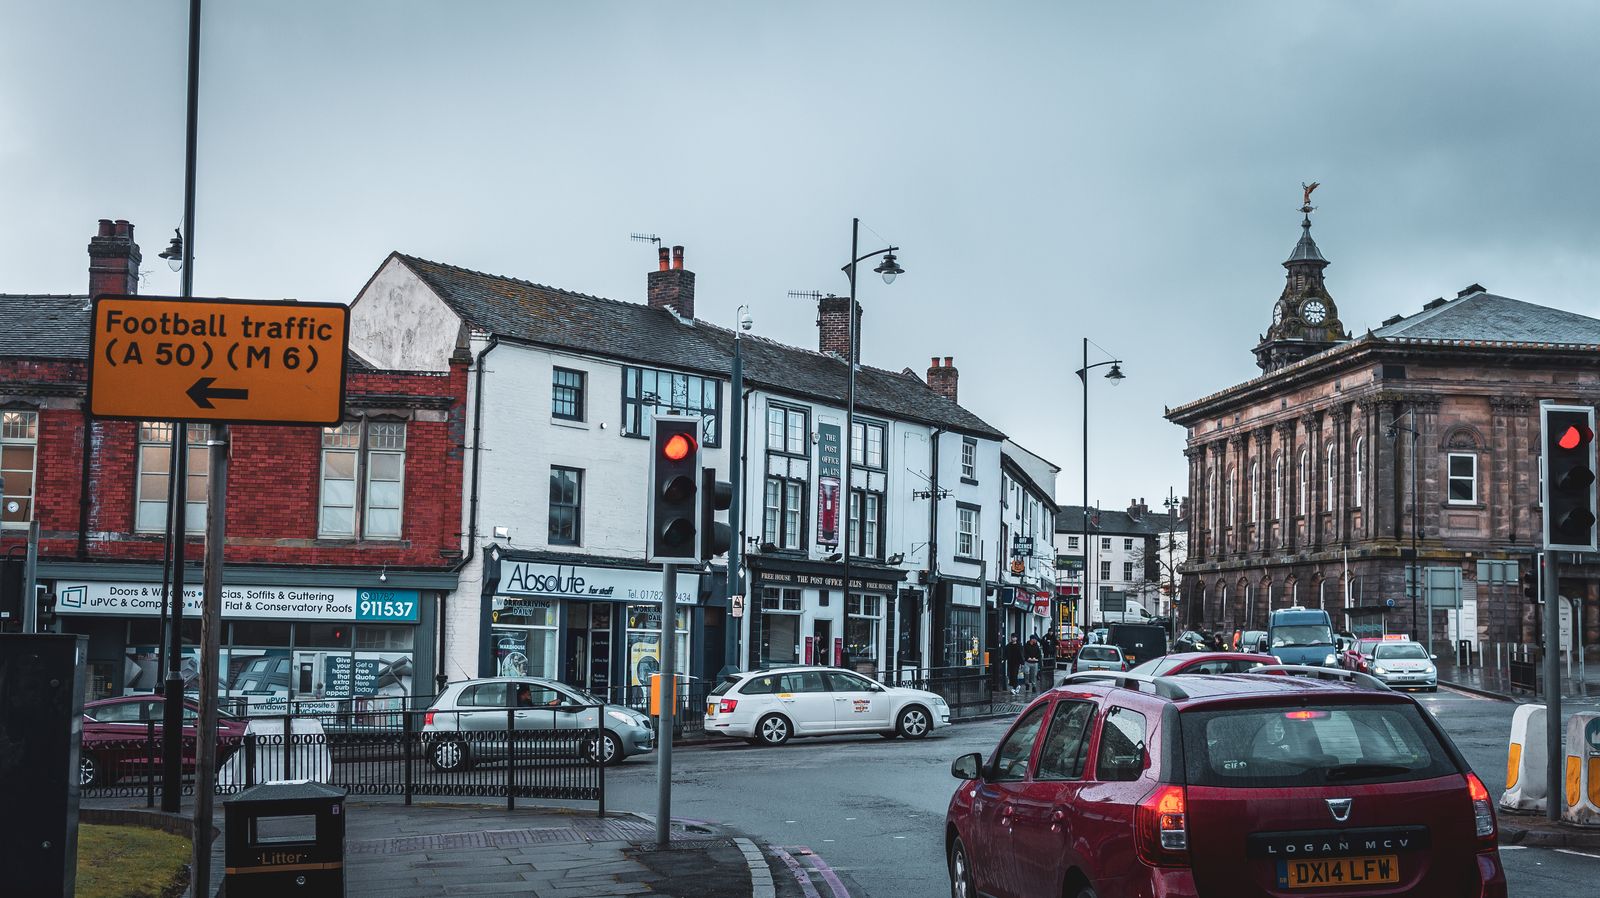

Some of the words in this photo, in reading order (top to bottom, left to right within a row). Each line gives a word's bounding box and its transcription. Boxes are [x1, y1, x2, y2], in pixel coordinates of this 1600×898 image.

[105, 309, 227, 338] Football
[241, 315, 333, 341] traffic
[105, 338, 143, 367] (A
[155, 341, 214, 370] 50)
[227, 342, 271, 371] (M
[282, 344, 319, 373] 6)
[825, 433, 837, 442] THE
[824, 444, 837, 454] POST
[821, 455, 840, 465] OFFICE
[507, 563, 585, 594] Absolute
[588, 584, 599, 594] for
[599, 586, 615, 595] staff
[761, 572, 775, 580] FREE
[774, 573, 792, 582] HOUSE
[797, 575, 809, 584] THE
[810, 576, 823, 585] POST
[824, 577, 843, 587] OFFICE
[110, 586, 139, 596] Doors
[141, 587, 149, 597] &
[246, 590, 275, 600] Soffits
[277, 591, 285, 600] &
[288, 591, 335, 603] Guttering
[628, 589, 639, 599] Tel.
[90, 597, 118, 607] uPVC
[120, 598, 128, 607] &
[225, 601, 243, 610] Flat
[245, 601, 253, 611] &
[255, 601, 323, 614] Conservatory
[325, 603, 353, 613] Roofs
[360, 601, 413, 617] 911537
[512, 607, 534, 617] DAILY
[253, 703, 286, 711] Windows
[1268, 842, 1349, 854] LOGAN
[1365, 839, 1409, 849] MCV
[261, 852, 302, 865] Litter
[1295, 860, 1344, 884] DX14
[1350, 858, 1391, 882] LFW
